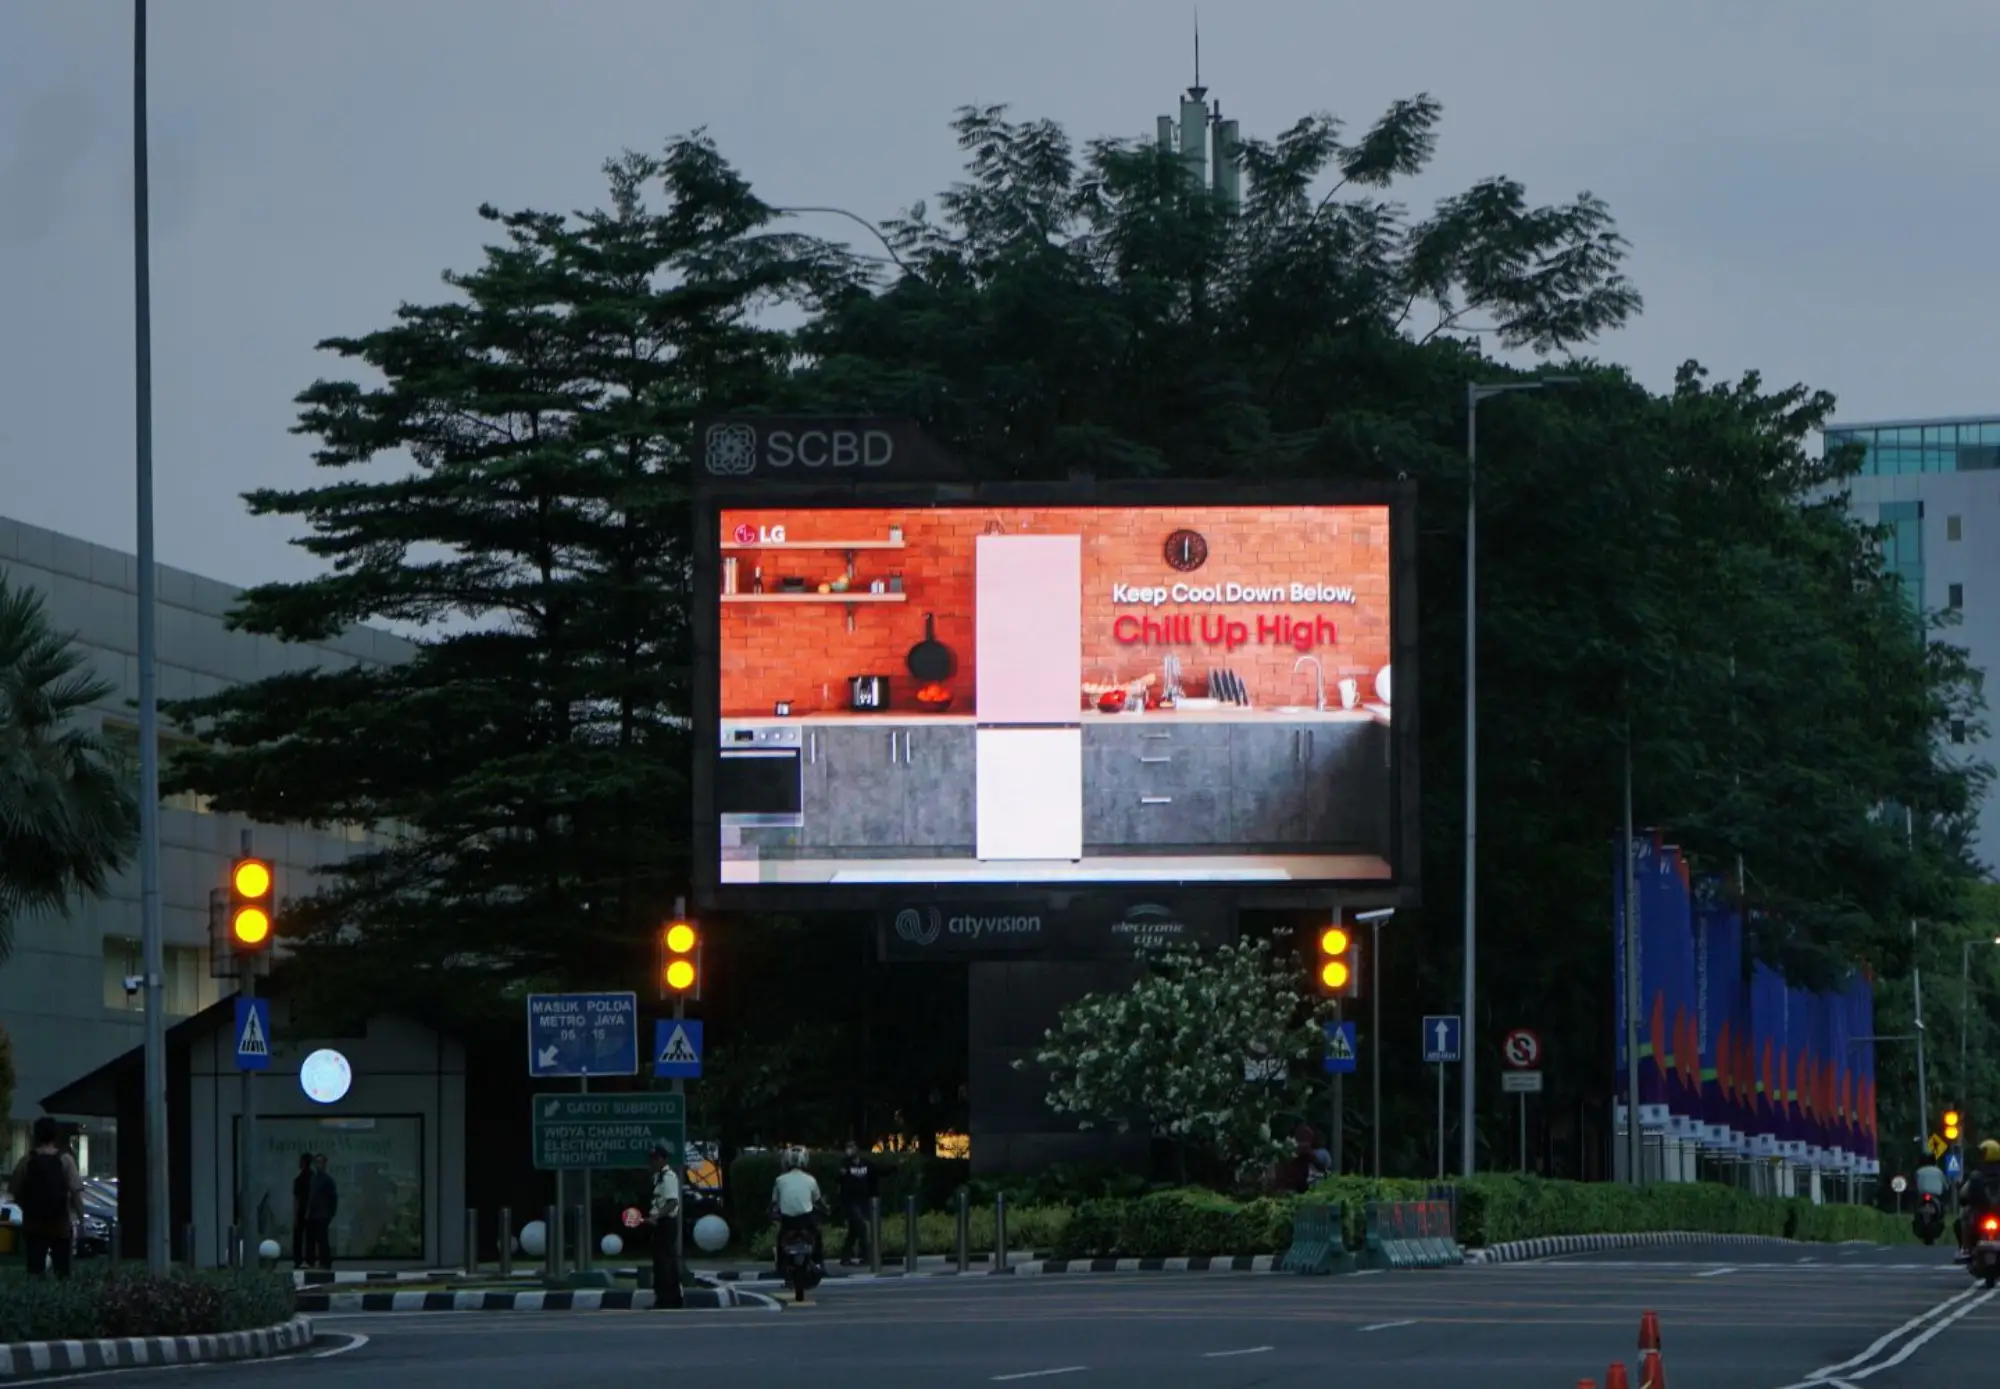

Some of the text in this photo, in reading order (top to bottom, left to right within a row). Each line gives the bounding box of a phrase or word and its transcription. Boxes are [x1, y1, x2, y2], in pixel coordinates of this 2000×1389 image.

[767, 431, 894, 467] SCBD
[759, 525, 786, 543] LG
[1113, 583, 1357, 606] Keep Cool Down Below,
[1113, 615, 1337, 650] Chill Up High
[532, 1000, 632, 1013] MASUK POLDA
[539, 1014, 625, 1027] METRO JAYA
[566, 1102, 676, 1114] GATOT SUBROTO
[543, 1126, 651, 1138] WIDYA CHANDRA
[544, 1139, 627, 1151] ELECTRONIC
